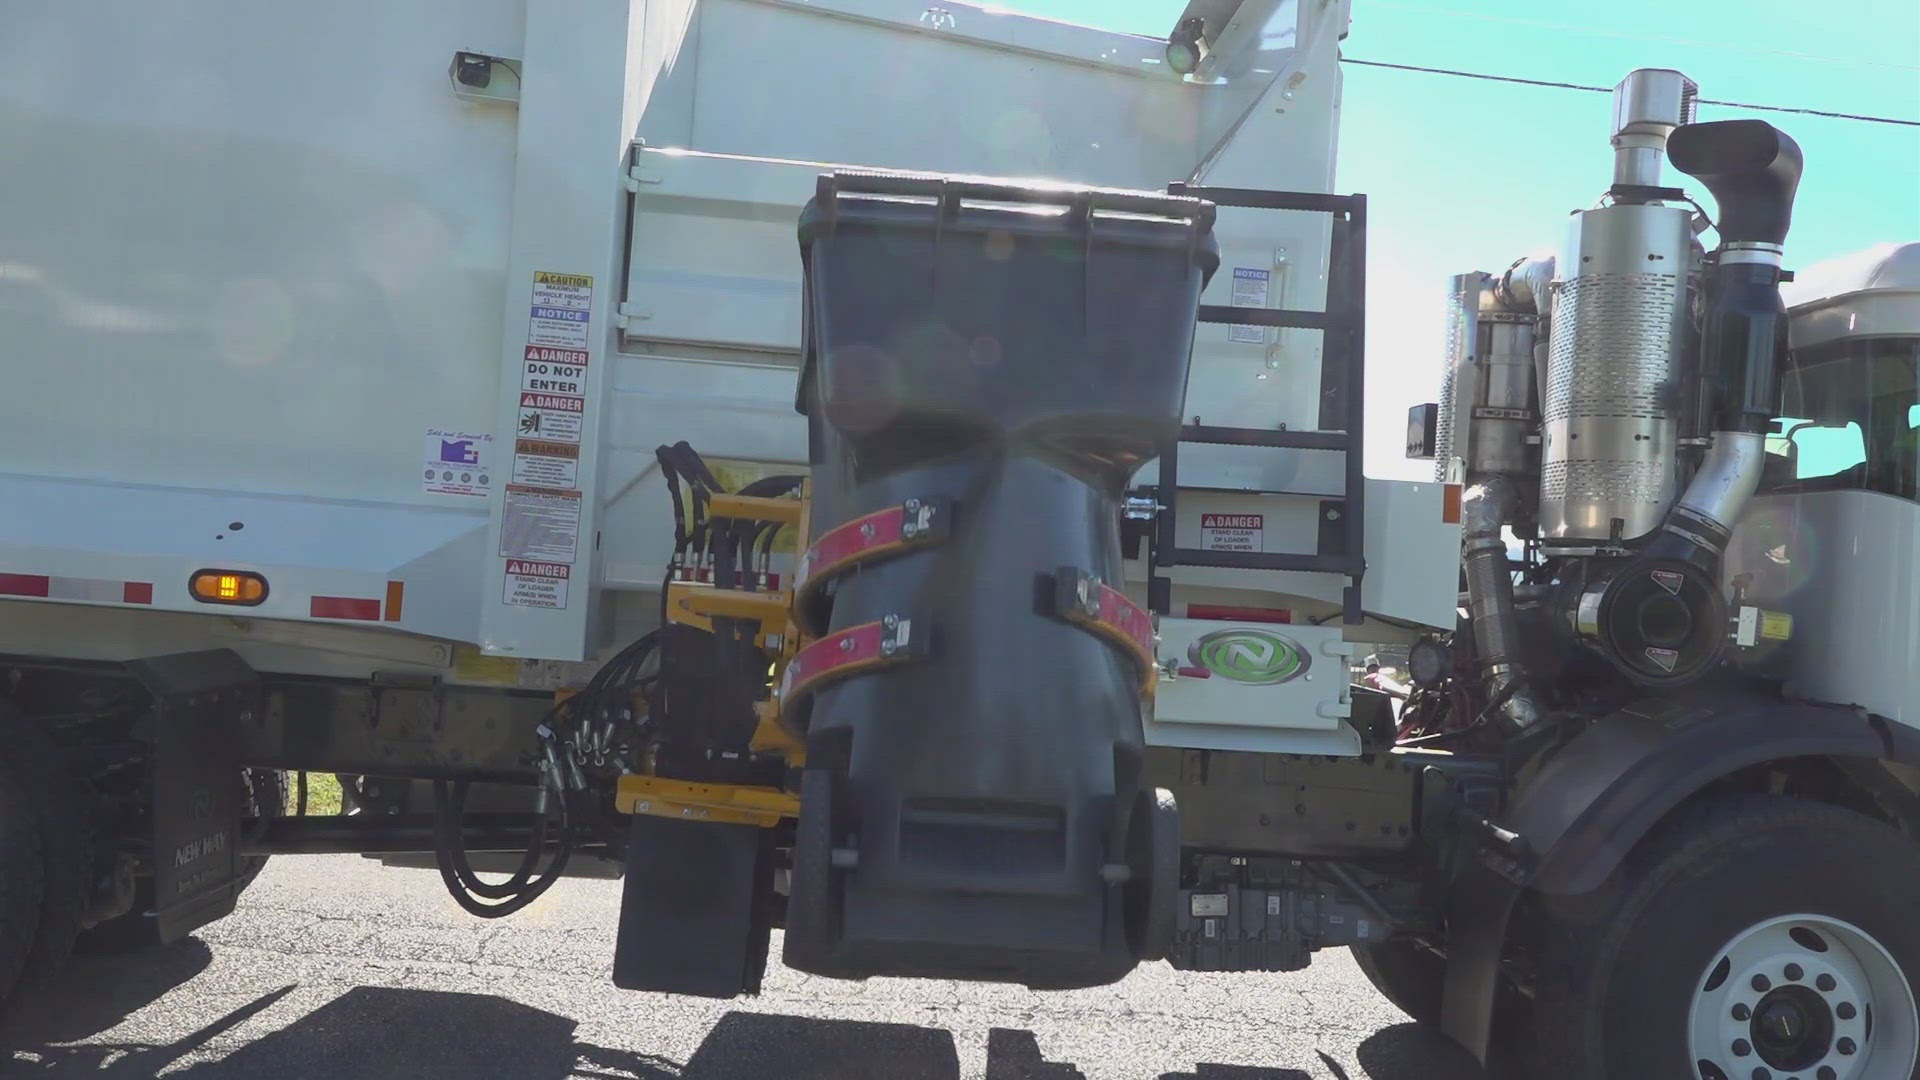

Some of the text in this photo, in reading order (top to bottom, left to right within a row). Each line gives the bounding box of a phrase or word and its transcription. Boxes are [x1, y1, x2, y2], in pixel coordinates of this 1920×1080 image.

[550, 275, 588, 286] CAUTION
[1235, 270, 1267, 279] NOTICE
[546, 285, 579, 293] MAXIMUM
[538, 309, 582, 320] NOTICE
[541, 350, 586, 364] DANGER
[528, 364, 582, 378] DO NOT
[530, 379, 577, 392] ENTER
[536, 396, 581, 411] DANGER
[531, 443, 577, 456] WARNING
[1217, 517, 1261, 527] DANGER
[523, 563, 567, 577] DANGER
[528, 584, 555, 592] LOADER
[174, 832, 226, 868] NEW WAY
